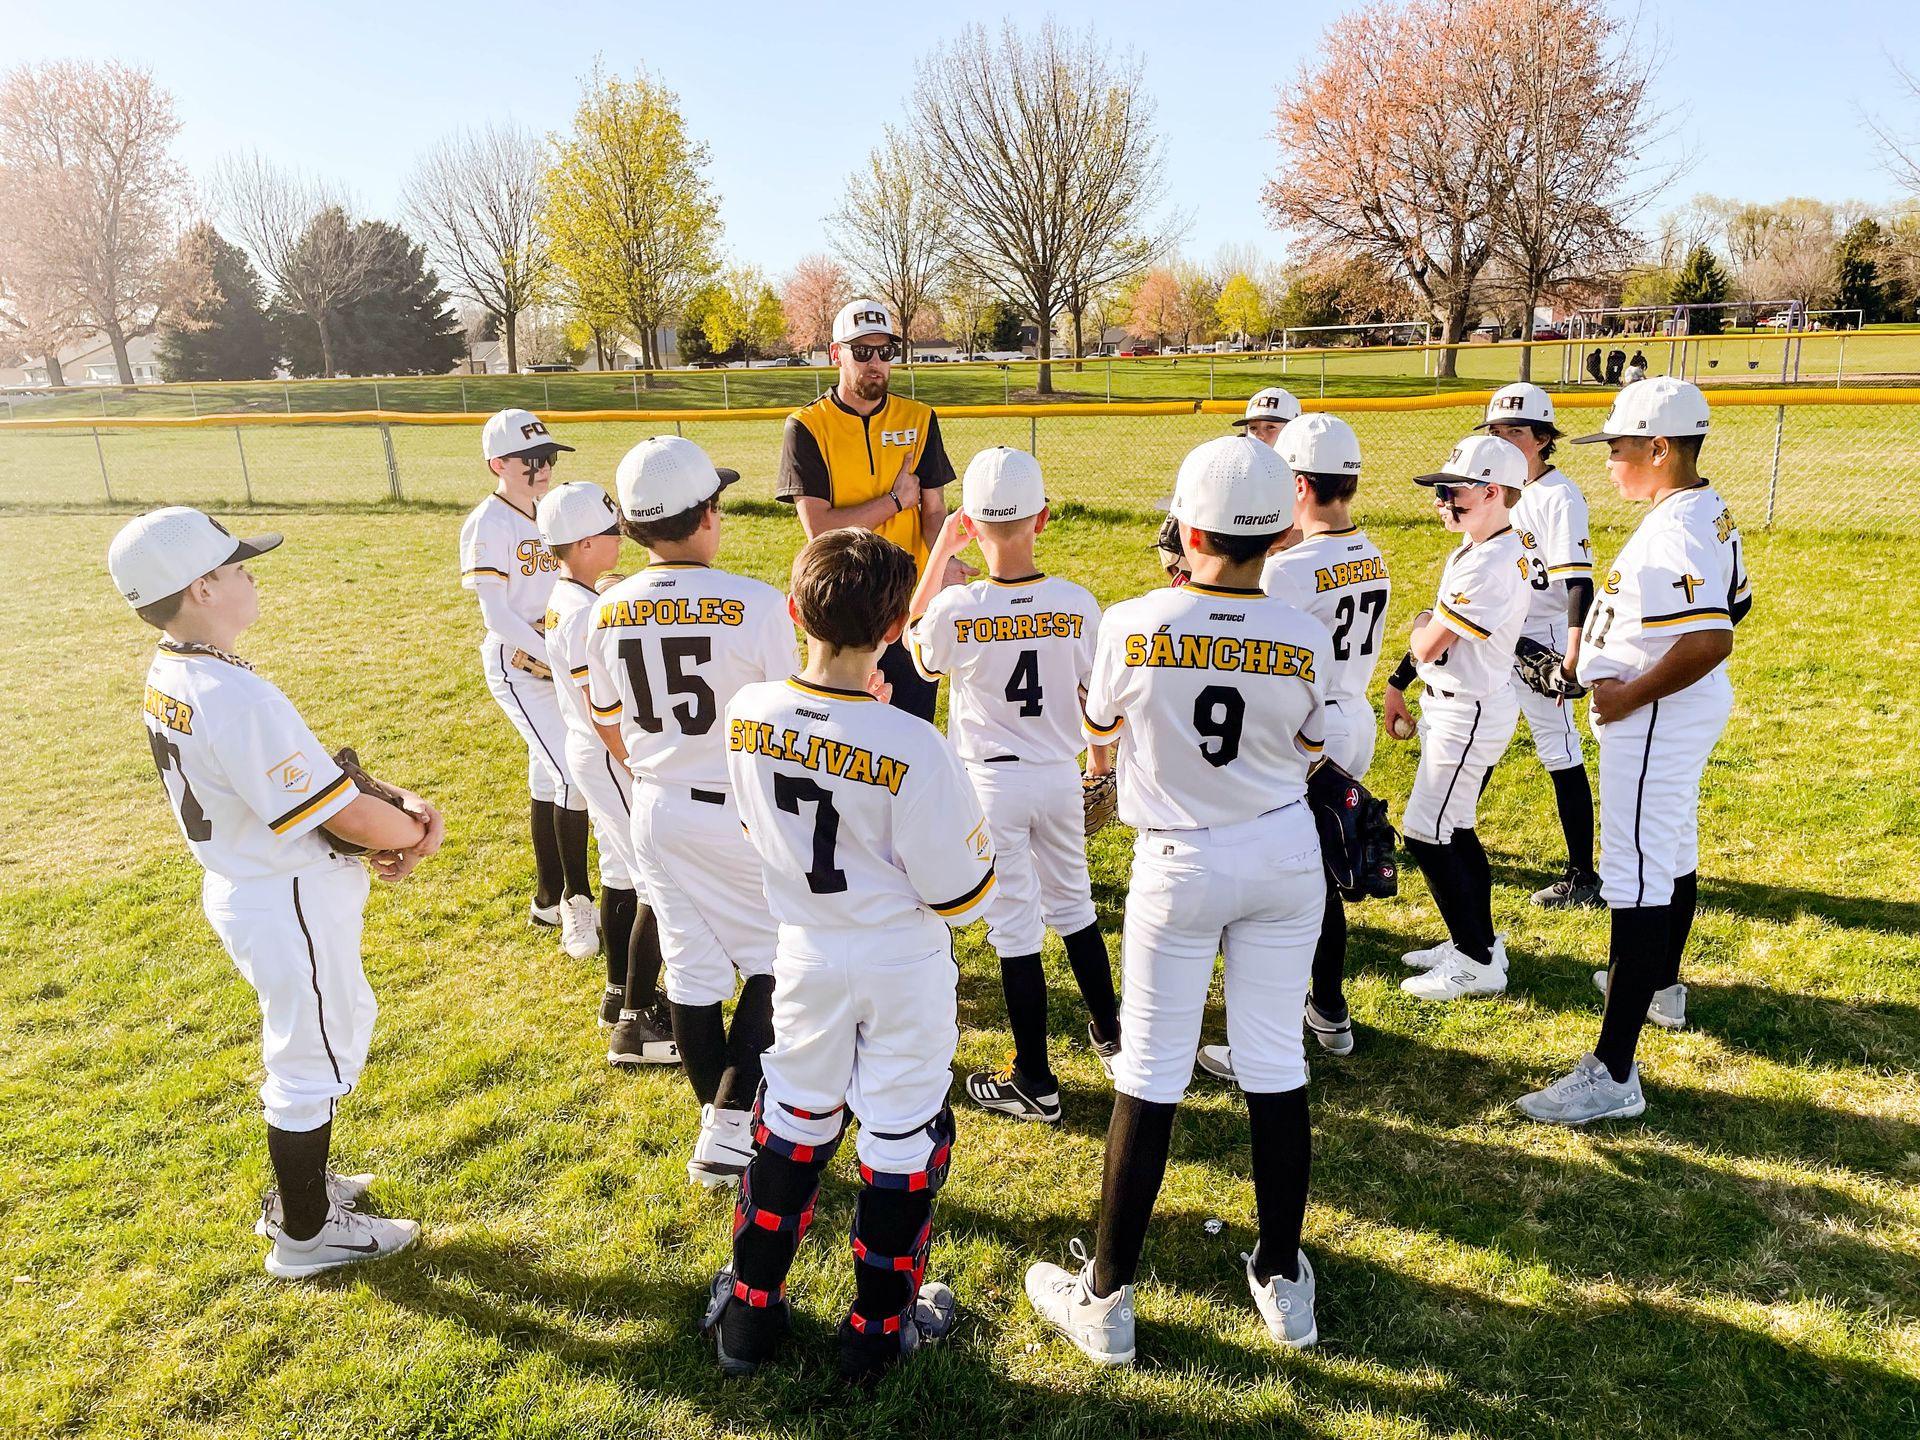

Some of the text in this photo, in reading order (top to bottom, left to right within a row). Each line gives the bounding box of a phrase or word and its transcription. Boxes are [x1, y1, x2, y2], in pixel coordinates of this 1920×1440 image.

[853, 310, 887, 328] FCA
[880, 427, 917, 448] FCA
[630, 502, 665, 518] marucci
[981, 504, 1018, 517] marucci
[1233, 509, 1281, 525] marucci
[648, 579, 677, 588] marucci
[1010, 595, 1034, 605] marucci
[597, 597, 746, 630] NAPOLES
[1209, 612, 1246, 623] marucci
[1332, 589, 1388, 661] 27
[954, 611, 1084, 643] FORREST
[1124, 624, 1316, 684] SÁNCHEZ
[618, 636, 718, 736] 15
[1004, 649, 1043, 718] 4
[795, 707, 830, 722] marucci
[1193, 685, 1246, 768] 9
[730, 718, 910, 797] SULLIVAN
[773, 771, 848, 895] 7
